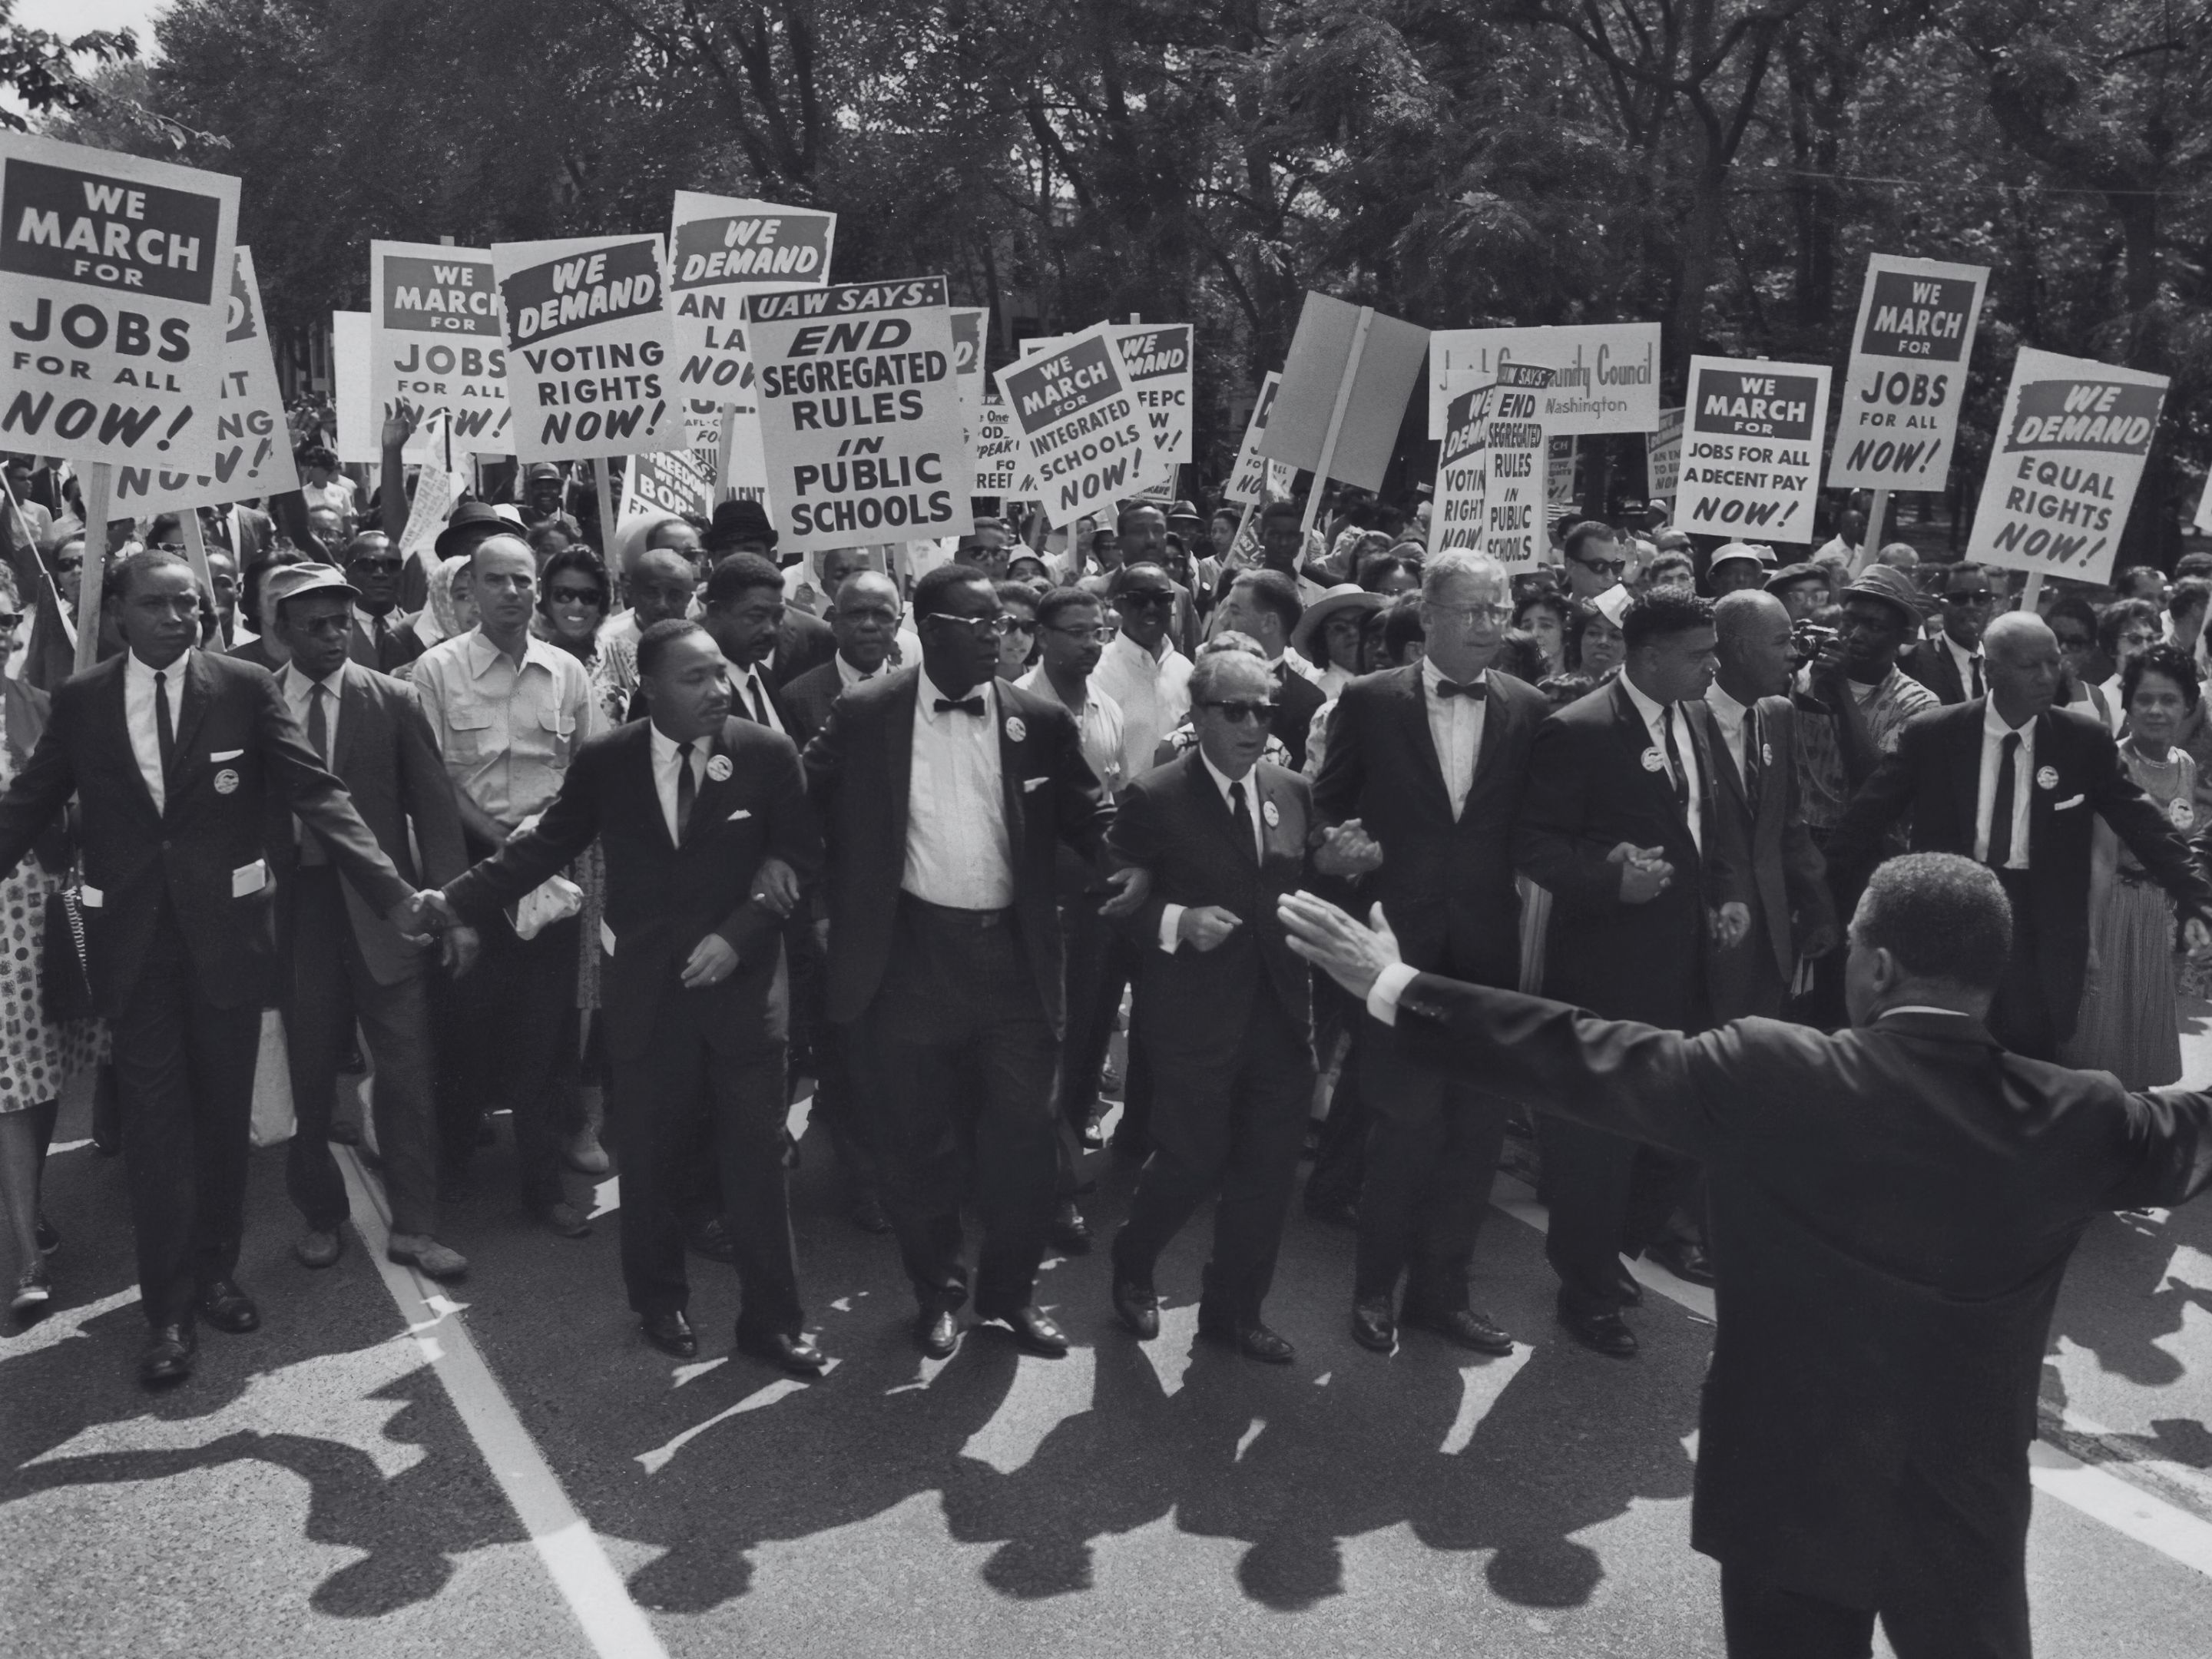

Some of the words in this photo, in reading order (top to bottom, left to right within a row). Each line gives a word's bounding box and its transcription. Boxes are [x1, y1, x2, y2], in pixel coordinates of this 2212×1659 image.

[83, 181, 146, 220] WE
[17, 207, 200, 272] MARCH
[724, 219, 781, 247] WE
[75, 260, 144, 287] FOR
[433, 265, 473, 286] WE
[552, 253, 607, 293] WE
[681, 246, 818, 282] DEMAND
[518, 274, 655, 338] DEMAND
[677, 293, 725, 320] AN
[757, 292, 830, 320] UAW
[837, 280, 940, 312] SAYS:
[1912, 281, 1942, 306] WE
[9, 298, 190, 363] JOBS
[431, 316, 475, 331] FOR
[1873, 305, 1963, 339] MARCH
[705, 326, 746, 352] LA
[787, 319, 912, 359] END
[1123, 333, 1157, 359] WE
[1898, 339, 1931, 354] FOR
[13, 352, 91, 379] FOR
[113, 368, 181, 392] ALL
[394, 344, 507, 379] JOBS
[523, 340, 664, 374] VOTING
[1039, 355, 1073, 381] WE
[1124, 347, 1184, 376] MAND
[1597, 342, 1652, 386] Council
[397, 379, 447, 395] FOR
[463, 384, 505, 399] ALL
[538, 373, 661, 406] RIGHTS
[762, 350, 948, 399] SEGREGATED
[1022, 360, 1108, 416] MARCH
[1740, 376, 1776, 396] WE
[1861, 371, 1948, 408] JOBS
[792, 389, 923, 431] RULES
[1054, 394, 1088, 416] FOR
[1137, 389, 1186, 407] FEPC
[1469, 387, 1494, 420] WE
[1498, 393, 1535, 419] END
[1704, 395, 1806, 422] MARCH
[2064, 384, 2121, 412] WE
[1, 390, 193, 452] NOW!
[541, 399, 666, 445] NOW!
[696, 430, 718, 443] FO
[1030, 399, 1131, 458] INTEGRATED
[1734, 422, 1773, 434] FOR
[1859, 412, 1896, 427] FOR
[1906, 415, 1937, 429] ALL
[2016, 415, 2151, 445] DEMAND
[837, 435, 885, 457] IN
[1040, 424, 1141, 482] SCHOOLS
[1446, 416, 1488, 459] DEMA
[1495, 452, 1532, 478] RULES
[1689, 442, 1734, 460] JOBS
[1739, 446, 1774, 463] FOR
[1777, 449, 1810, 466] ALL
[1846, 438, 1941, 473] NOW!
[793, 452, 942, 496] PUBLIC
[1061, 446, 1142, 511] NOW!
[1445, 469, 1485, 492] VOTIN
[1684, 467, 1698, 482] A
[1701, 469, 1768, 488] DECENT
[1772, 474, 1808, 492] PAY
[2017, 455, 2114, 500] EQUAL
[1444, 498, 1484, 522] RIGHT
[1504, 487, 1520, 502] IN
[2005, 485, 2112, 531] RIGHTS
[790, 491, 952, 535] SCHOOLS
[1490, 504, 1532, 532] PUBLIC
[1692, 496, 1800, 528] NOW!
[1487, 535, 1532, 562] SCHOOLS
[1993, 522, 2107, 568] NOW!
